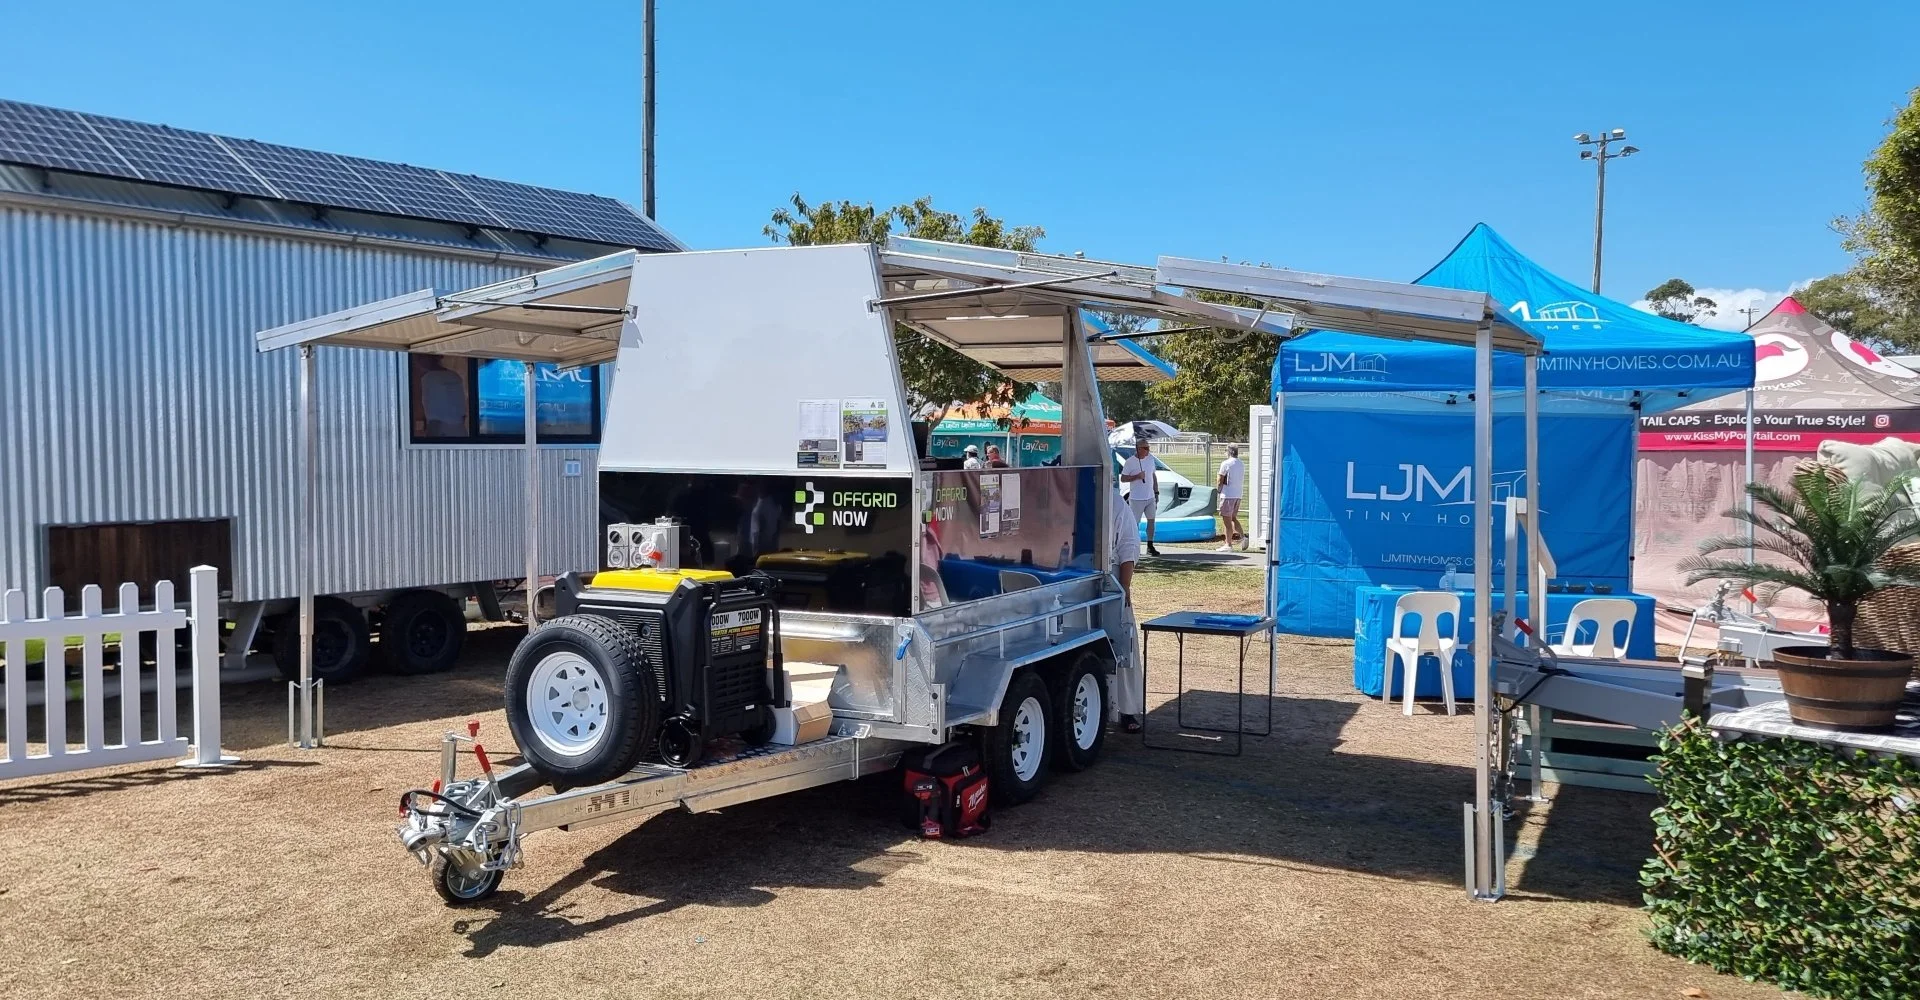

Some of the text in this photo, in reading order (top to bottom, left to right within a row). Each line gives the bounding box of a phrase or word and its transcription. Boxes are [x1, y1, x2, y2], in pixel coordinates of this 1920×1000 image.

[1295, 352, 1356, 372] LJM
[1536, 353, 1742, 371] JMTINYHOMES.COM.AU
[1752, 379, 1807, 391] onytail
[1668, 415, 1700, 426] CAPS
[1714, 414, 1762, 427] Exploe
[1763, 414, 1792, 425] Your
[1795, 415, 1824, 425] True
[1826, 415, 1866, 428] Style!
[1664, 431, 1800, 442] www.KissMyPotail.com
[1022, 440, 1049, 453] LayZen
[1346, 461, 1472, 502] LJM
[832, 491, 897, 508] OFFGRID
[935, 486, 968, 503] OFFGRID
[832, 511, 868, 527] NOW
[935, 504, 954, 522] NOW
[1345, 509, 1411, 522] TINY
[1381, 553, 1505, 568] LJMTINYHOMES.CA
[712, 614, 729, 625] 000W
[738, 610, 759, 622] 7000W
